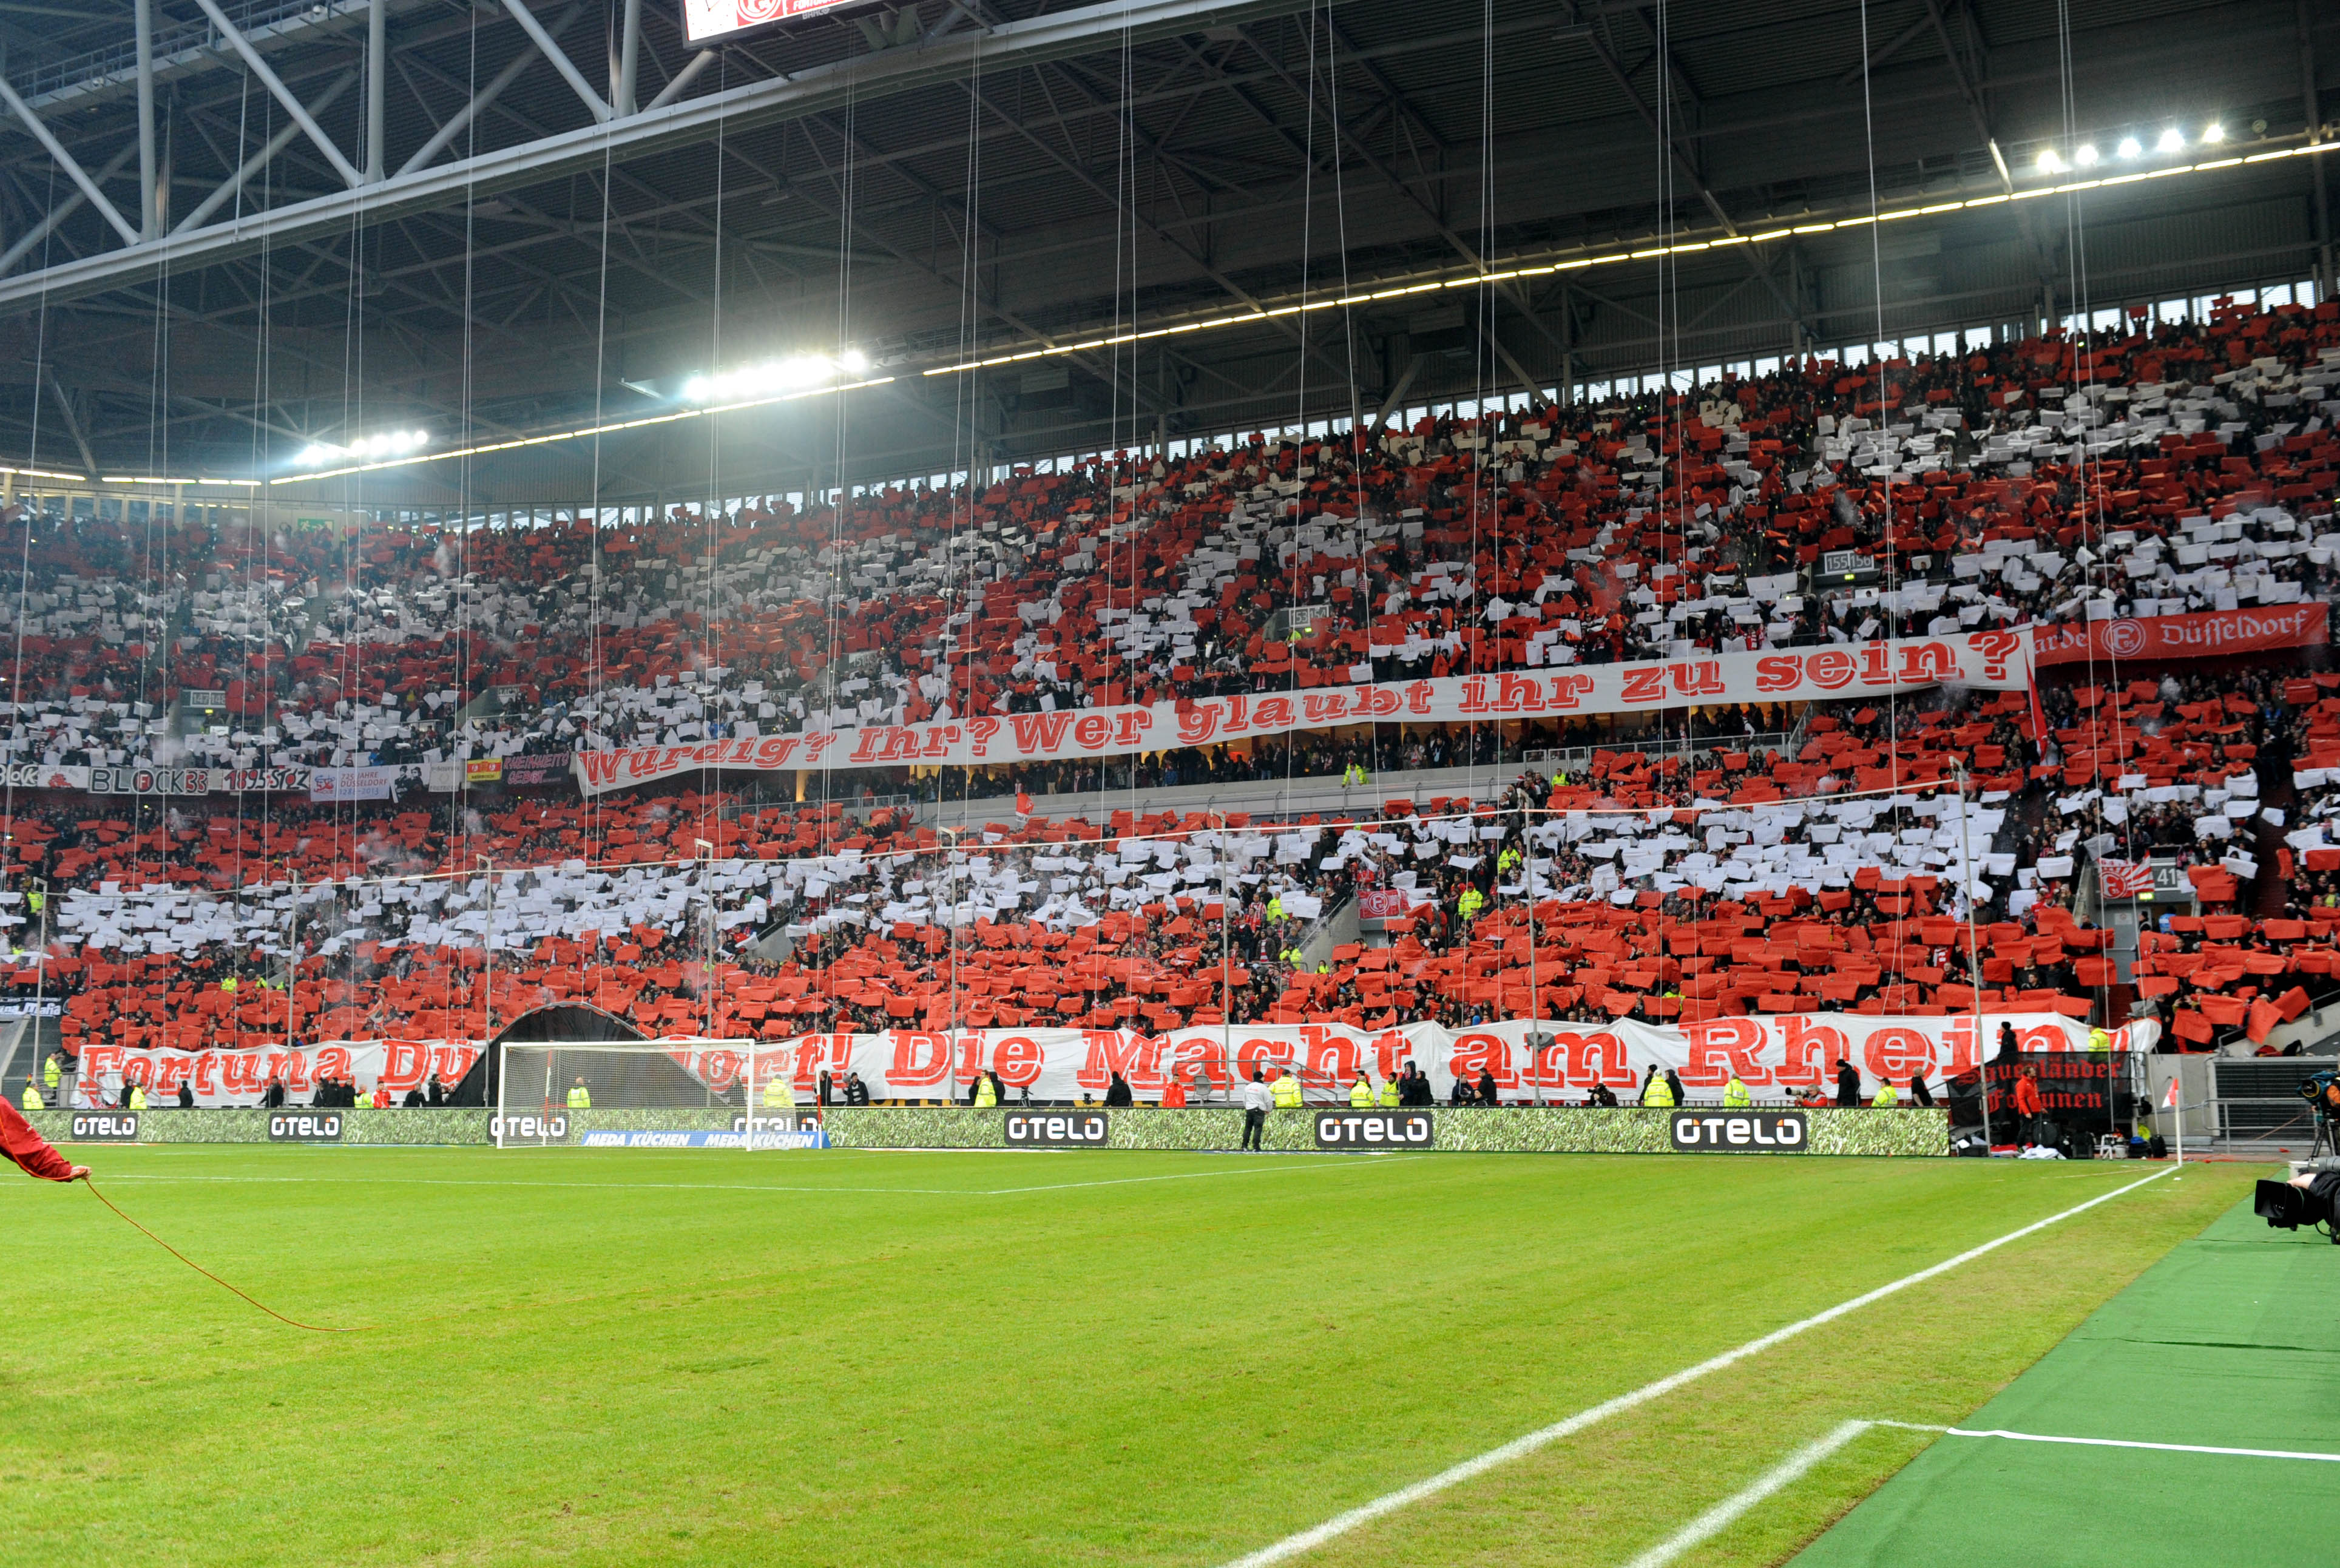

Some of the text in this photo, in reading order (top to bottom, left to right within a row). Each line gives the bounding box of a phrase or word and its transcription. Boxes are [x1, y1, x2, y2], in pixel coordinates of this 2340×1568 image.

[1827, 556, 1847, 569] 155
[1851, 554, 1871, 569] 156
[579, 630, 2020, 786] Würdig? Ihr? Wer glaubt ihr zu sein?
[2157, 868, 2176, 885] 41
[79, 1045, 356, 1096] Fortuna
[885, 1029, 1045, 1088] Die
[1077, 1026, 1413, 1090] Macht
[1449, 1032, 1637, 1089] am
[585, 1134, 624, 1146] MEDA
[629, 1132, 691, 1146] KÜCHEN
[704, 1134, 748, 1147] MEDA
